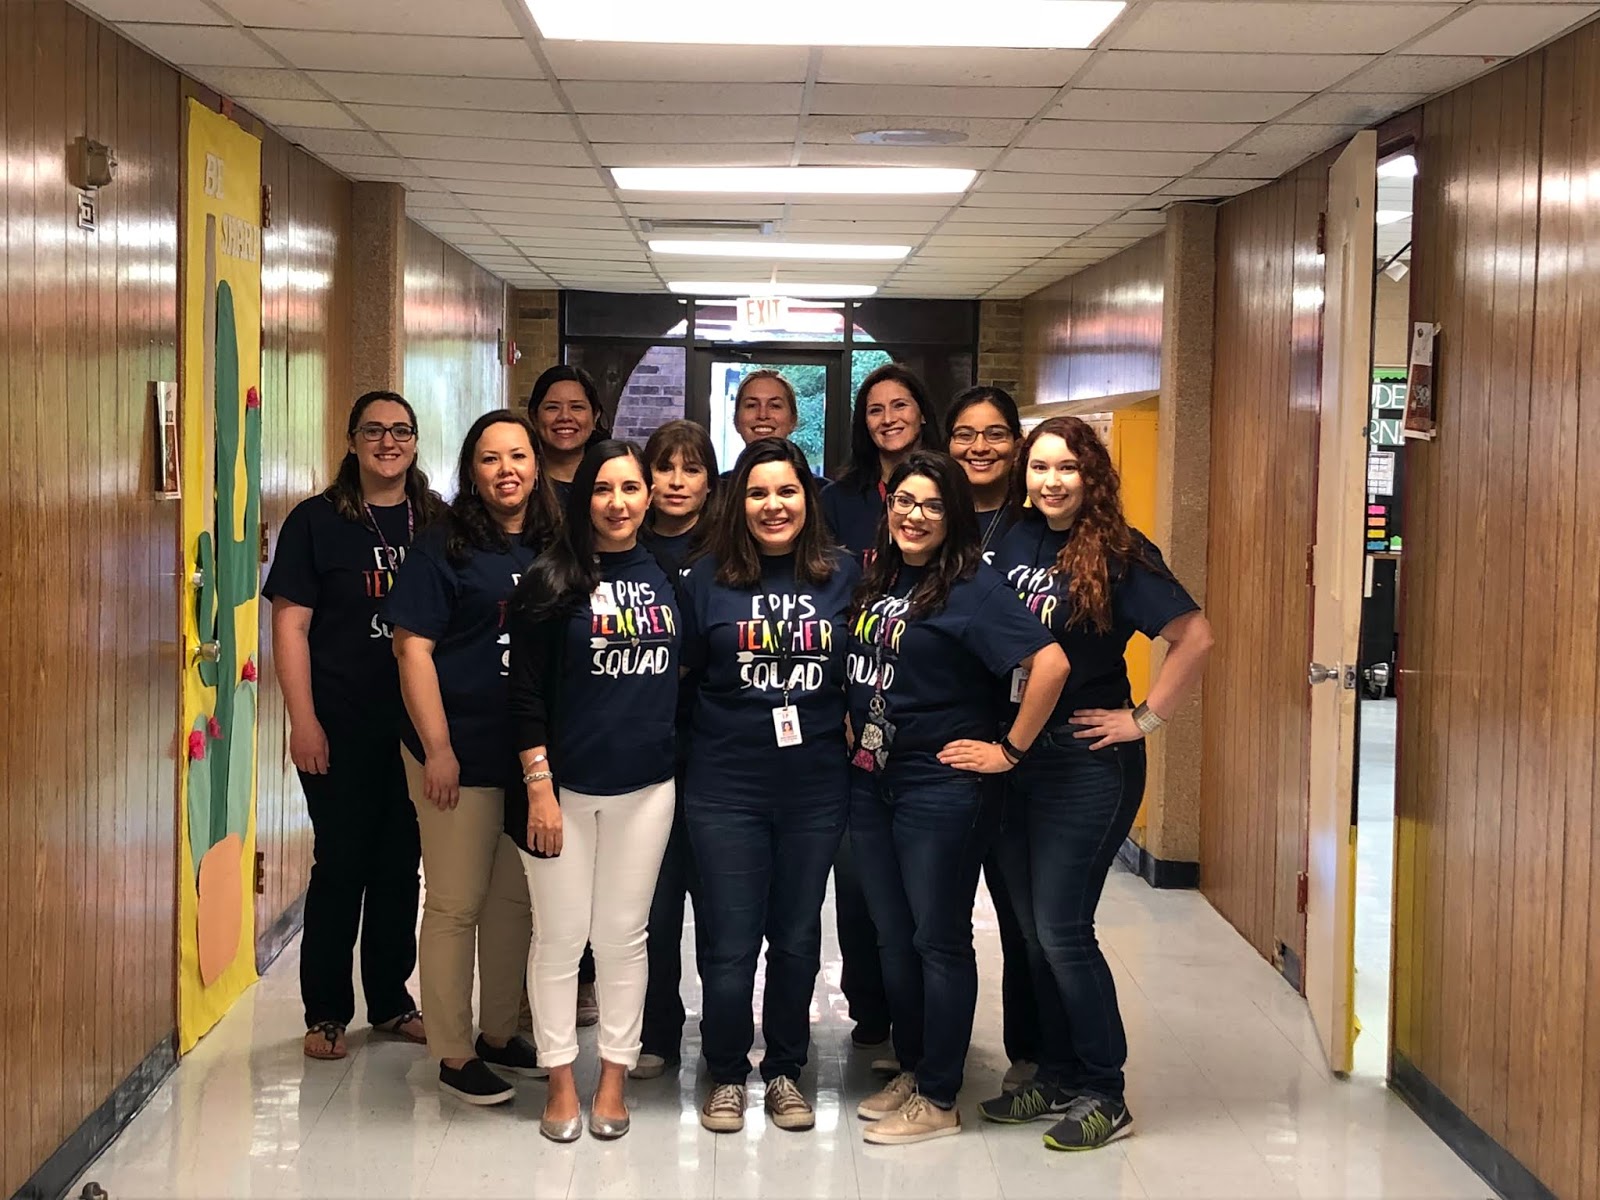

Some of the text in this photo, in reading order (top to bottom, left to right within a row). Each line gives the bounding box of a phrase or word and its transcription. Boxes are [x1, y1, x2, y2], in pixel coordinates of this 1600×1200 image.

[204, 152, 225, 200] BE
[746, 299, 781, 326] EXIT
[1371, 383, 1407, 409] DE
[615, 580, 656, 608] PHS
[752, 593, 817, 620] EPHS
[589, 604, 676, 638] TEACHER
[590, 646, 670, 679] SQUAD
[740, 661, 824, 692] SQUAD
[846, 653, 895, 691] QUAD
